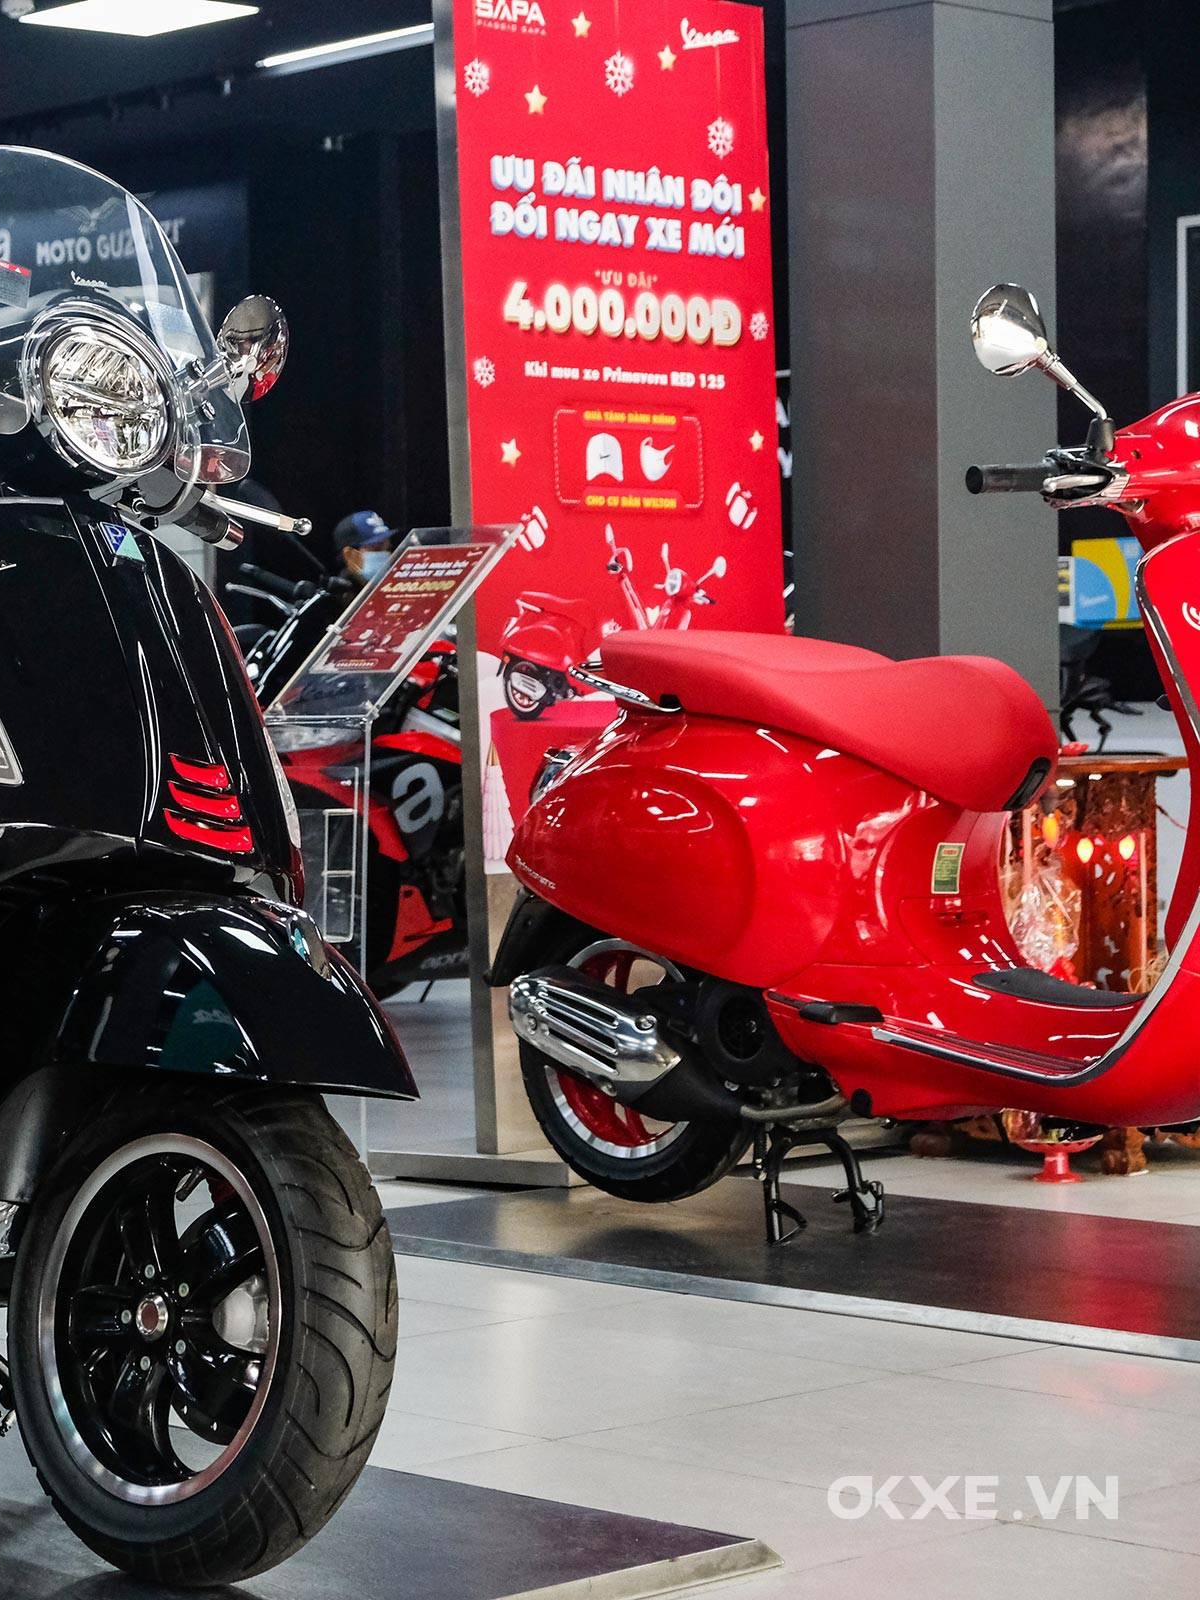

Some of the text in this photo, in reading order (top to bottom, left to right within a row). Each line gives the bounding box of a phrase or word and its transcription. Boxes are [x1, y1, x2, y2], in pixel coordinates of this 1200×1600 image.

[680, 17, 740, 50] Vespa
[490, 155, 535, 192] ƯU
[601, 165, 685, 209] NHÂN
[554, 207, 640, 247] NGAY
[645, 216, 683, 253] XE
[687, 216, 746, 260] MỚI
[36, 236, 91, 267] MOTO
[524, 360, 548, 377] Khi
[551, 366, 580, 380] mua
[670, 371, 696, 388] RED
[699, 373, 726, 390] 125
